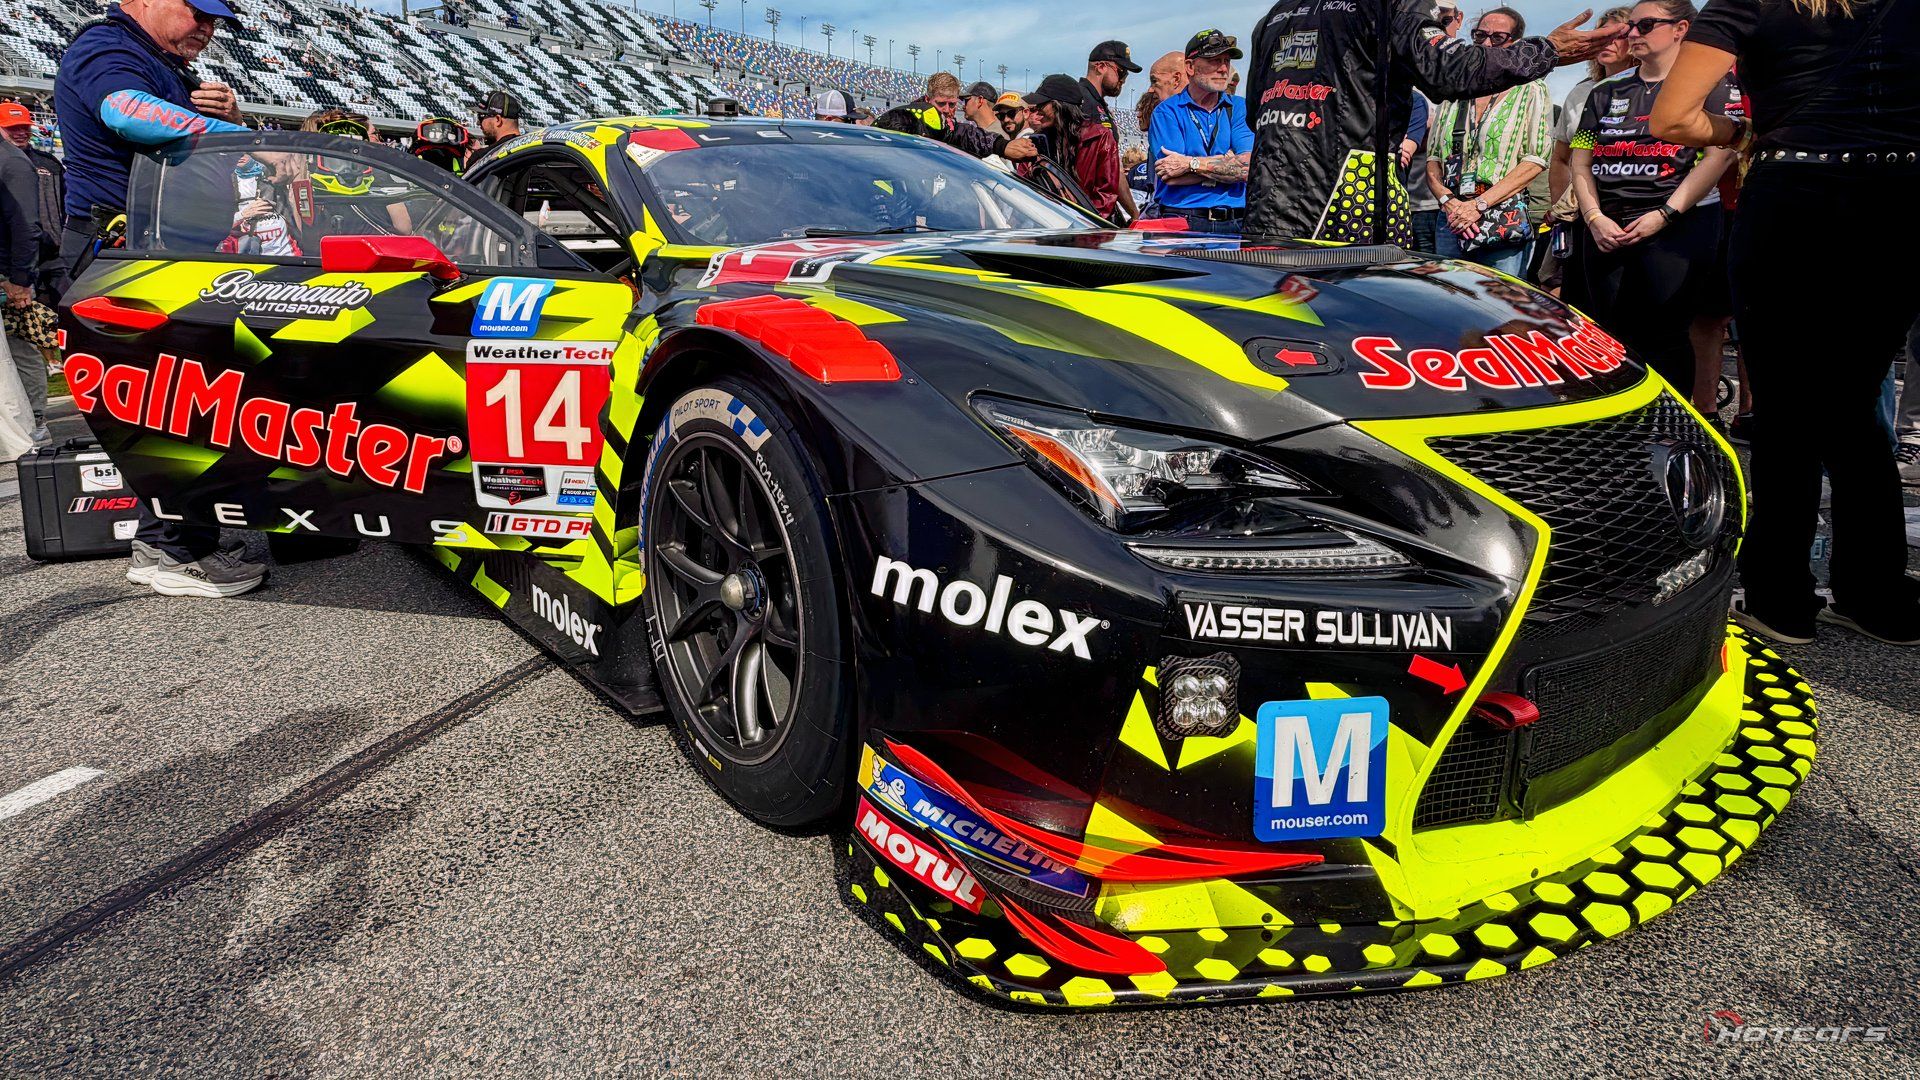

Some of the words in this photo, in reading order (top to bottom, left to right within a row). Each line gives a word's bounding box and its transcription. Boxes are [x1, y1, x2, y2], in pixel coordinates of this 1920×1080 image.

[698, 131, 941, 148] LEXUS
[1592, 141, 1682, 157] ealMaster
[1592, 162, 1658, 176] endava
[200, 270, 372, 306] Bommarito
[246, 301, 341, 316] AUTOSPORT
[473, 345, 613, 361] WeatherTech
[58, 329, 447, 495] ealMaster
[485, 369, 592, 461] 14
[674, 400, 693, 417] PILOT
[694, 398, 721, 410] SPORT
[93, 466, 118, 478] bsi
[151, 497, 468, 544] LEXUS
[511, 517, 562, 534] GTD
[1184, 601, 1306, 643] VASSER
[1315, 610, 1452, 651] SULLIVAN
[1270, 812, 1369, 831] mouser.com
[859, 809, 978, 905] MOTUL
